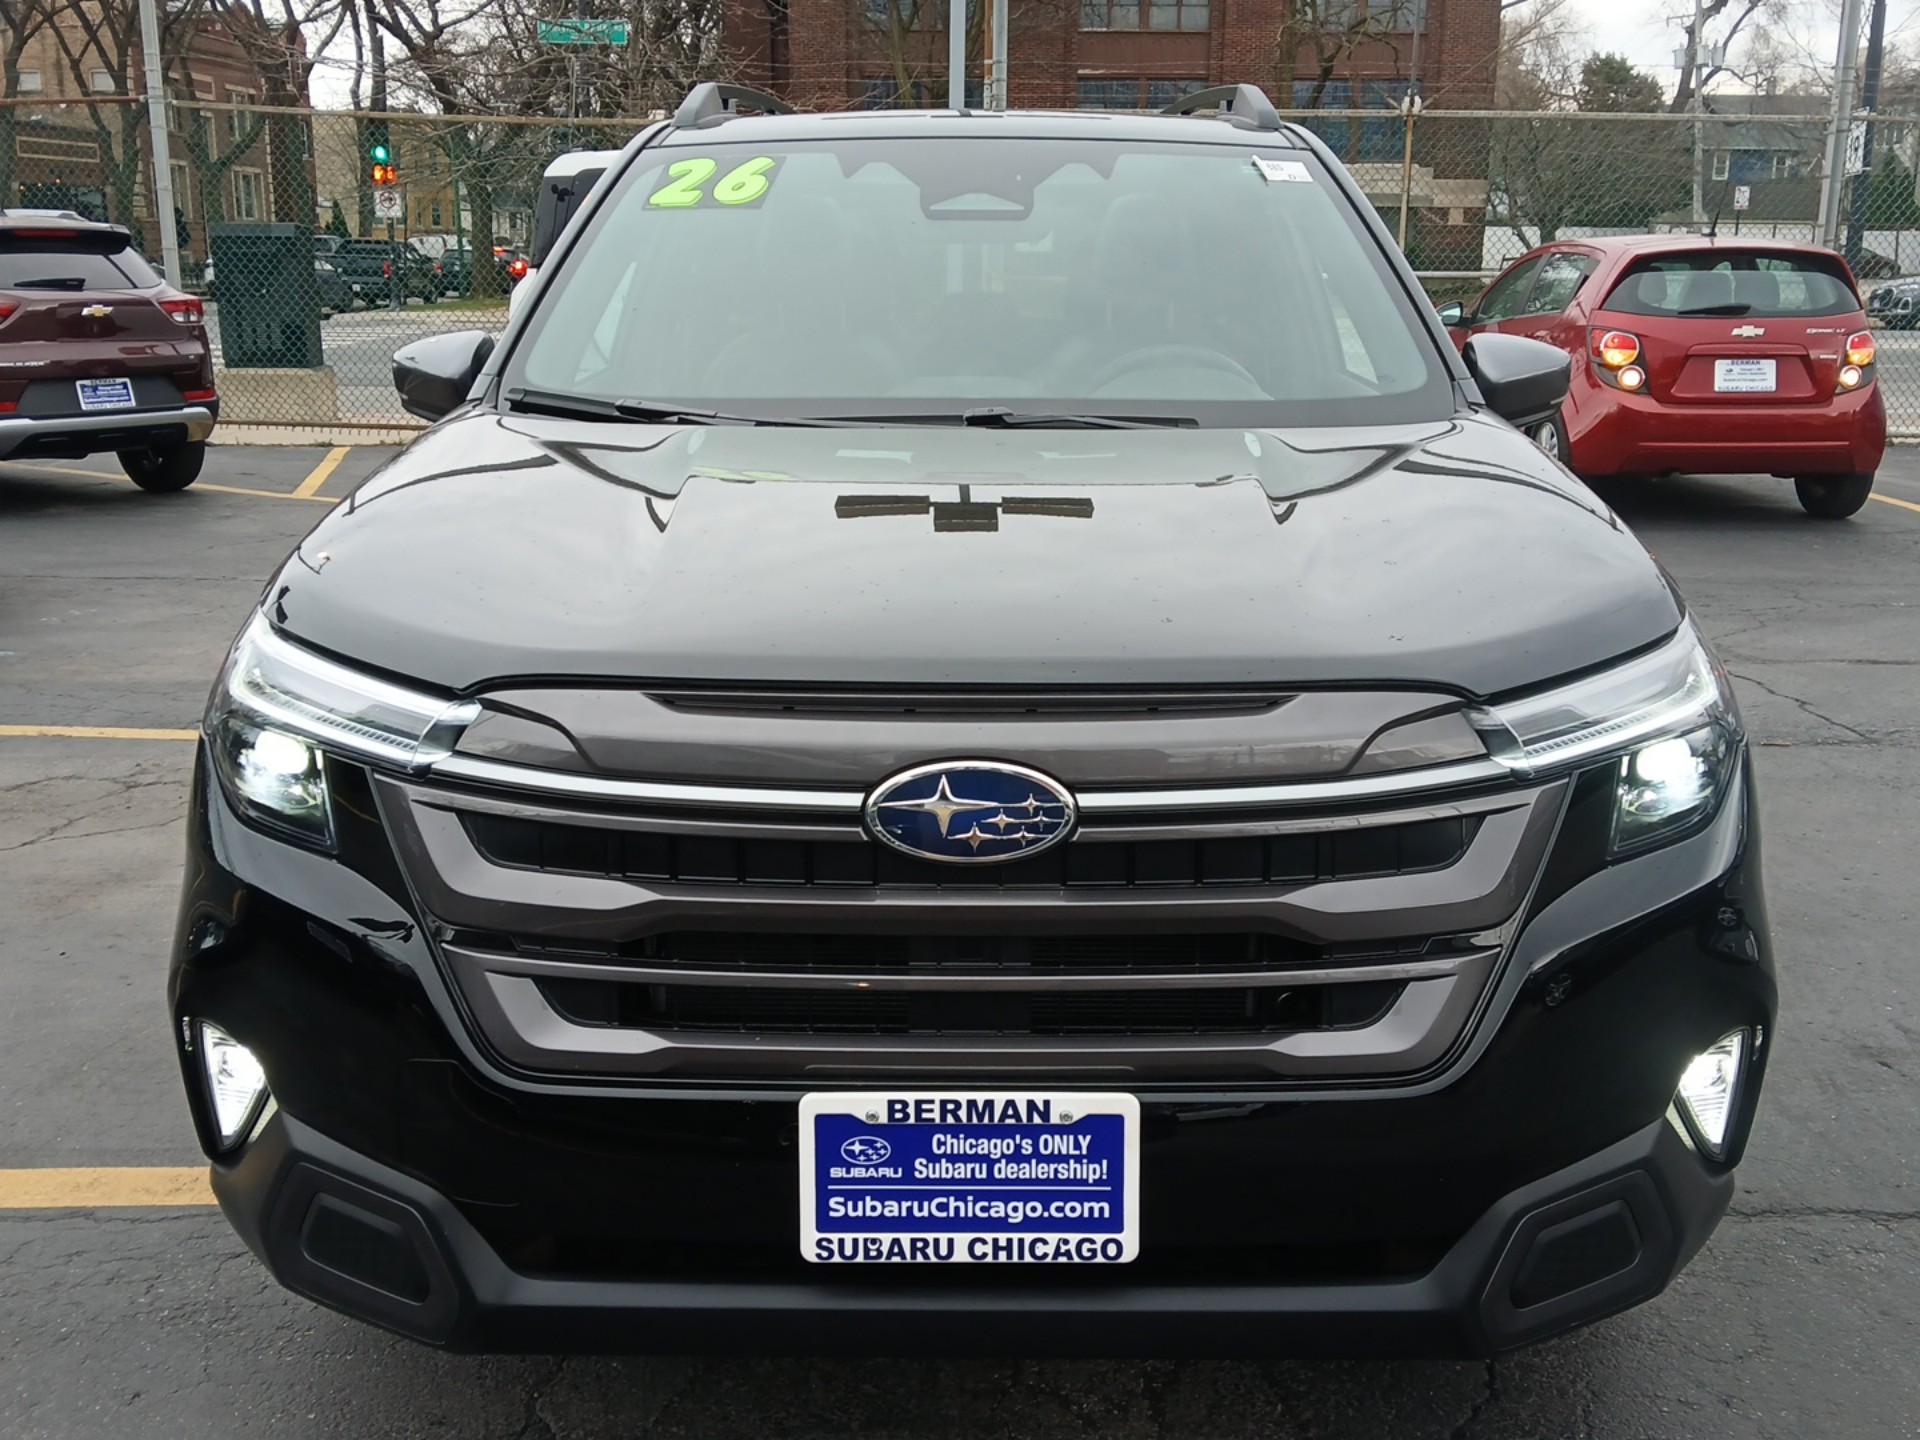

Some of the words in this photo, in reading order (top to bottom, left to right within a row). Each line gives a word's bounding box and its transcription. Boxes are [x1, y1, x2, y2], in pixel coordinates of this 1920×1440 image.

[649, 156, 776, 208] 26
[887, 1099, 1051, 1124] BERMAN
[931, 1133, 1033, 1159] Chicago's
[1038, 1134, 1092, 1155] ONLY
[829, 1167, 903, 1178] SUBARU
[914, 1158, 988, 1179] Subaru
[993, 1158, 1108, 1184] dealership!
[828, 1195, 1110, 1224] SubaruChicago.com
[815, 1237, 954, 1261] SUBARU
[967, 1237, 1124, 1261] CHICAGO
